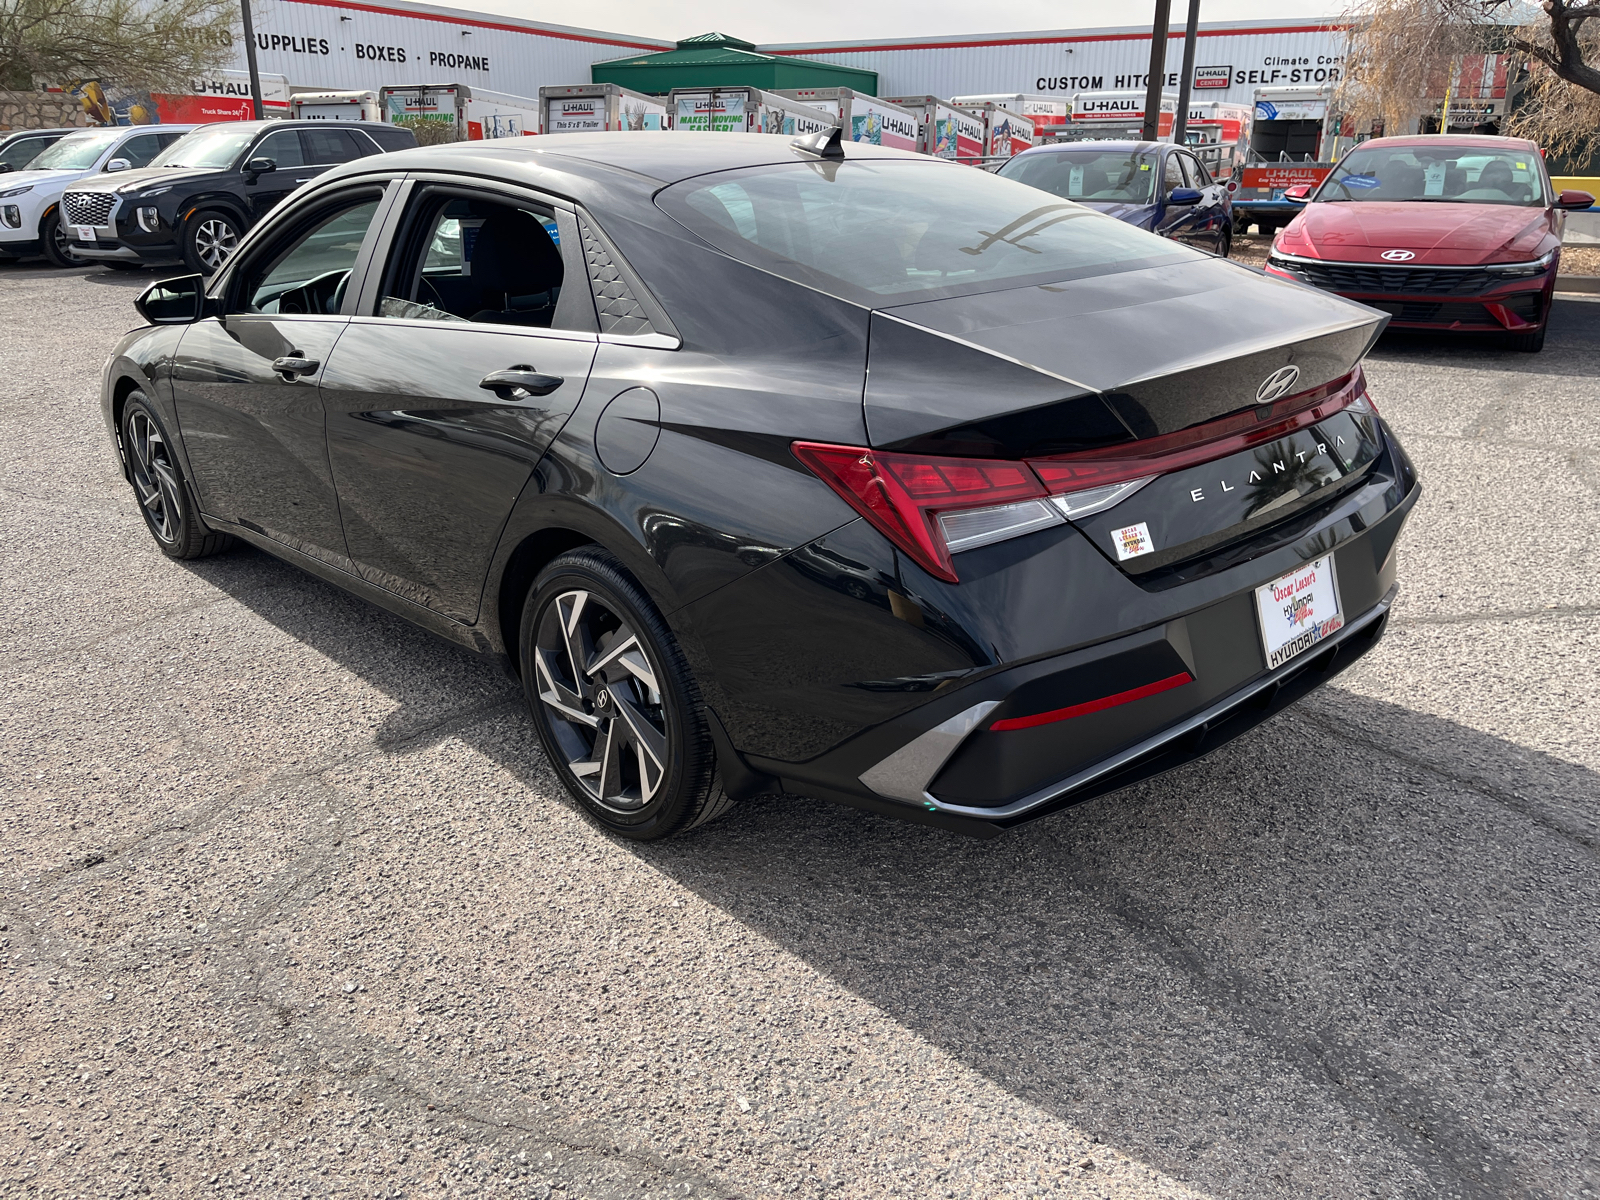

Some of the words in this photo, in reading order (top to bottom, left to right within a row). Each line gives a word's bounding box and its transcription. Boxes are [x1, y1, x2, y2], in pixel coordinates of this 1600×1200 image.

[356, 43, 407, 63] BOXES
[430, 51, 490, 71] PROPANE
[1264, 56, 1309, 66] Climate
[1317, 55, 1345, 65] Cont
[1036, 76, 1104, 90] CUSTOM
[1114, 73, 1182, 89] HITCE
[1235, 68, 1342, 84] SELF-STOR
[405, 97, 437, 106] U-HAUL
[563, 103, 594, 112] U-HAUL
[695, 101, 726, 109] U-HAUL
[1083, 100, 1139, 111] U-HAUL
[201, 107, 216, 115] Truck
[422, 113, 454, 123] MOVING
[679, 115, 708, 124] MAKES
[711, 114, 744, 124] MOVING
[556, 121, 567, 129] This
[797, 118, 829, 134] U-HA
[881, 115, 915, 138] U-HAUL
[956, 120, 982, 141] U-HAUL
[1011, 123, 1032, 142] U-HAUL
[1266, 169, 1315, 178] U-HAUL
[1190, 435, 1346, 503] ELANTRA
[1273, 584, 1294, 603] Oscar
[1283, 592, 1314, 617] HYUNDAI
[1271, 631, 1314, 667] HYUNDAI
